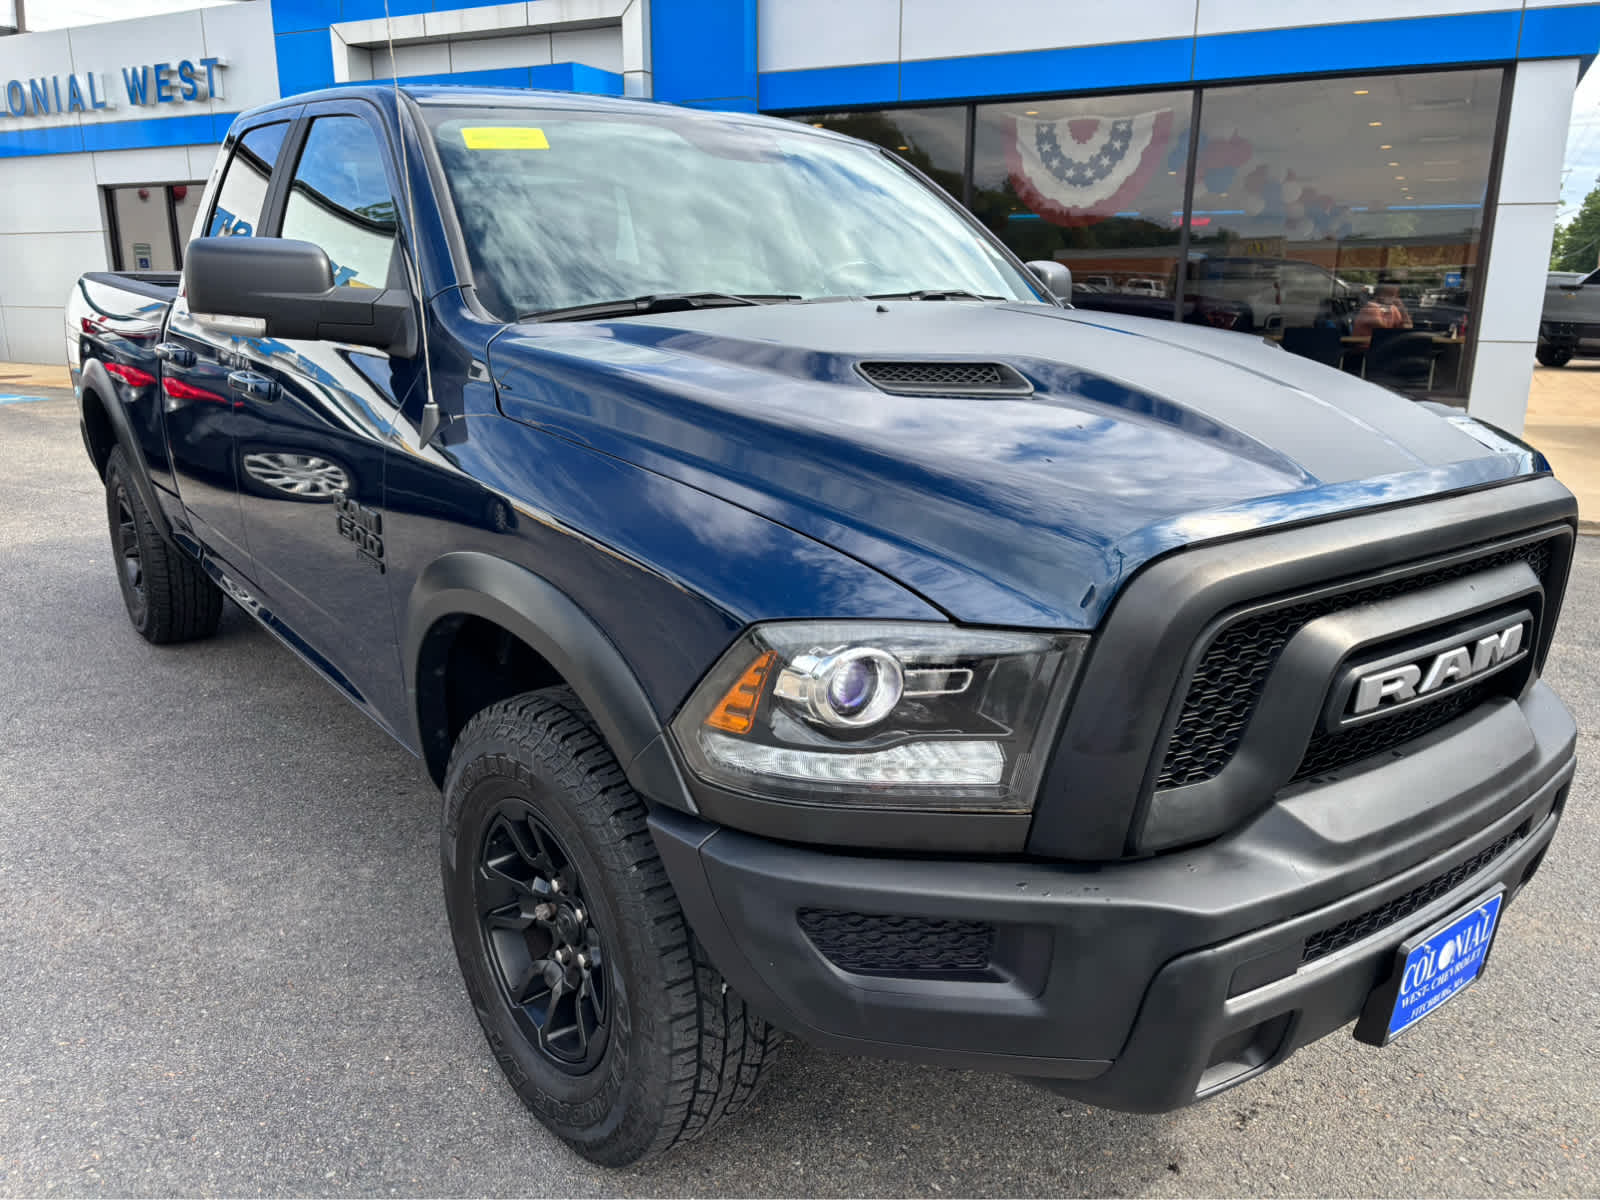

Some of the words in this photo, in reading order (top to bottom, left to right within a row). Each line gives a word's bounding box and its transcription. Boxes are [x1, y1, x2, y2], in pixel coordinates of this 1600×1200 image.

[122, 58, 219, 106] WEST
[1355, 623, 1523, 713] RAM
[1400, 914, 1491, 995] COLONIAL
